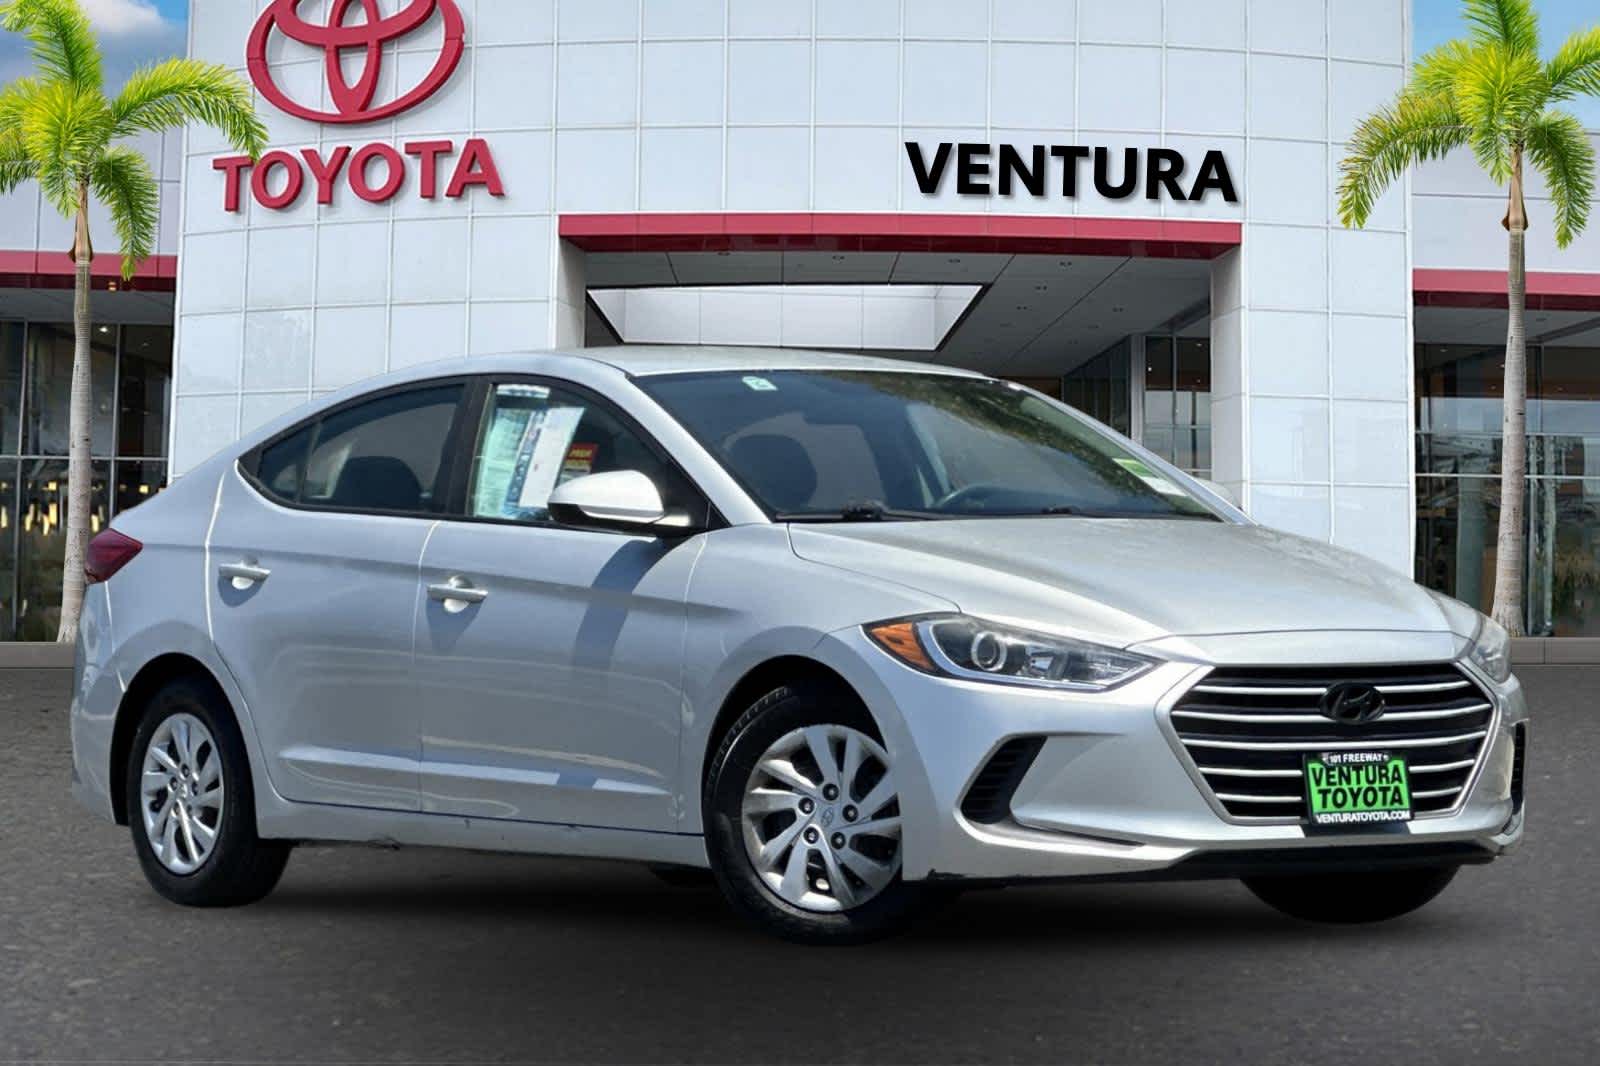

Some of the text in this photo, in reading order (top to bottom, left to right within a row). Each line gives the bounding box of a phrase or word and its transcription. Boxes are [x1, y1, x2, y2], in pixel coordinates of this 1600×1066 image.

[212, 138, 505, 212] TOYOTA
[904, 141, 1239, 203] VENTURA
[1311, 765, 1403, 787] VENTURA
[1317, 786, 1403, 808] TOYOTA
[1316, 811, 1410, 823] VENTURATOYOTA.COM
